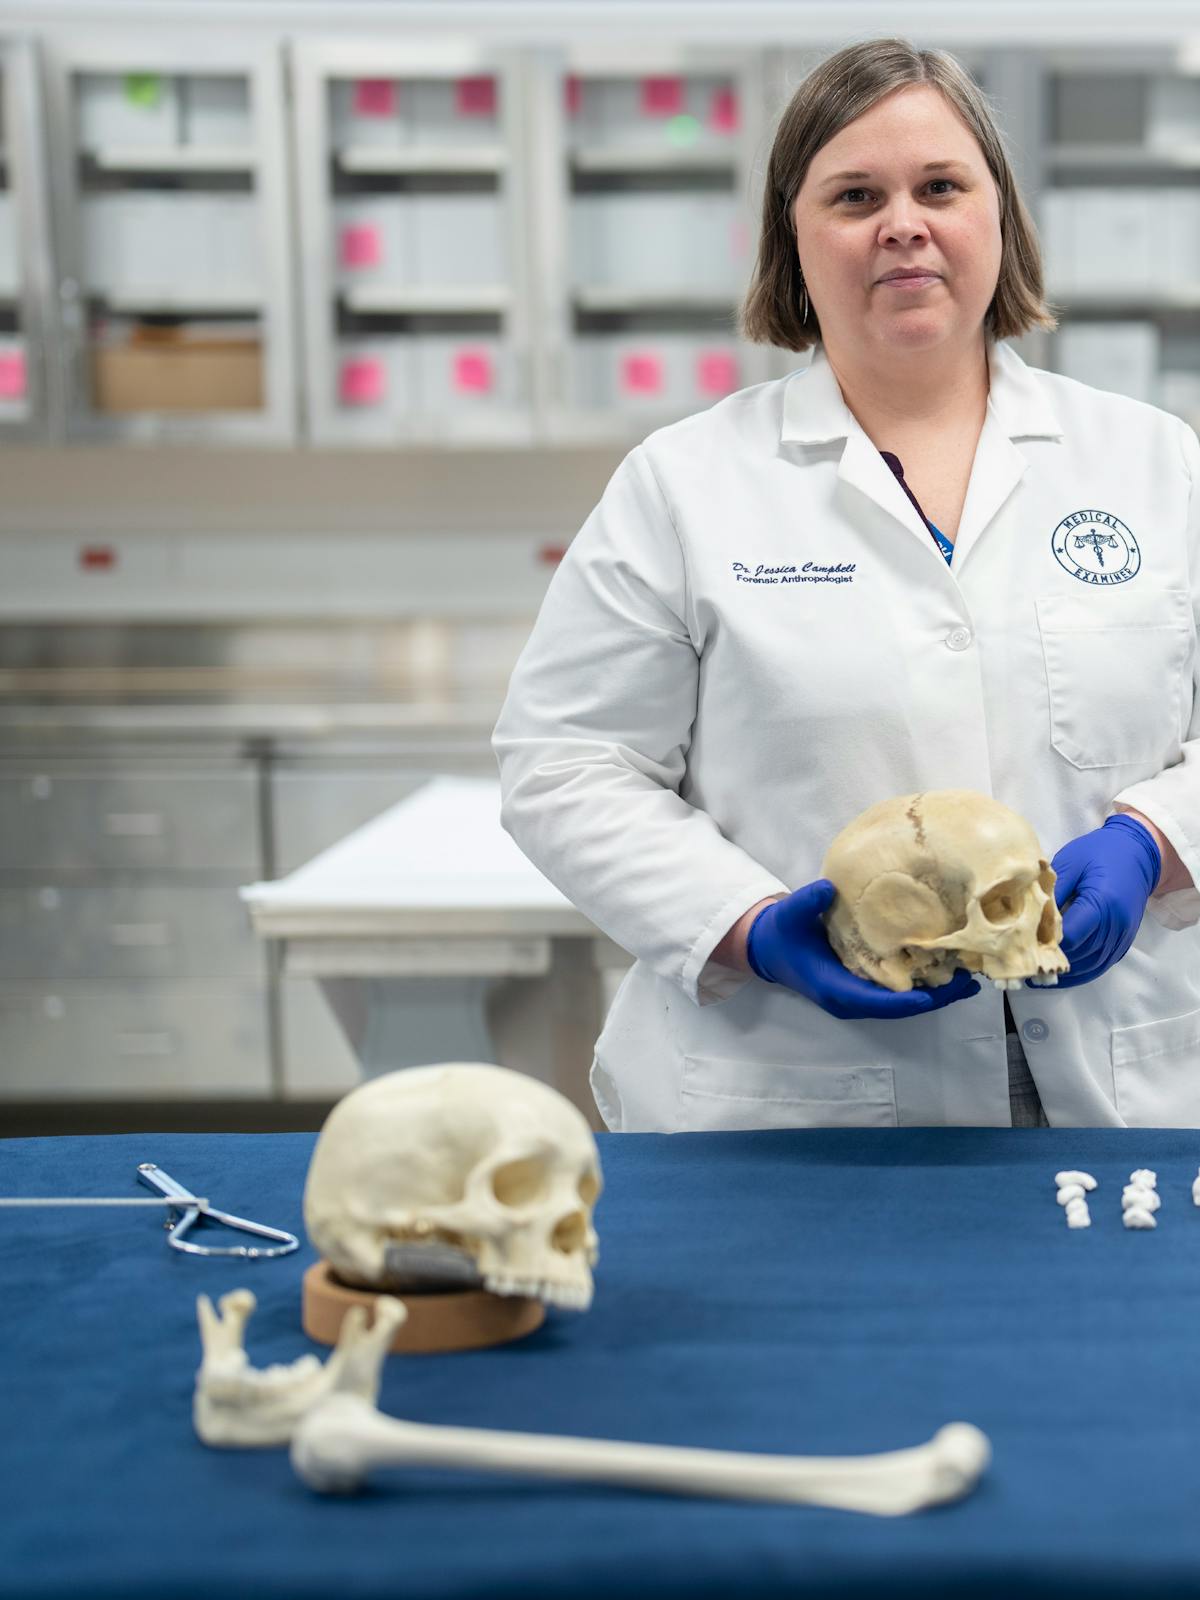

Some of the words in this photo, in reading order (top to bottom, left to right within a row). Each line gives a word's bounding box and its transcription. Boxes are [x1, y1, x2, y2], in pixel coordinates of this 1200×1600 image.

[1063, 511, 1118, 529] MEDICAL
[755, 564, 797, 576] Jessica
[802, 561, 857, 575] Campbell
[1074, 567, 1134, 583] EXAMINER
[736, 574, 779, 584] Forensic
[780, 574, 854, 585] Anthropologist
